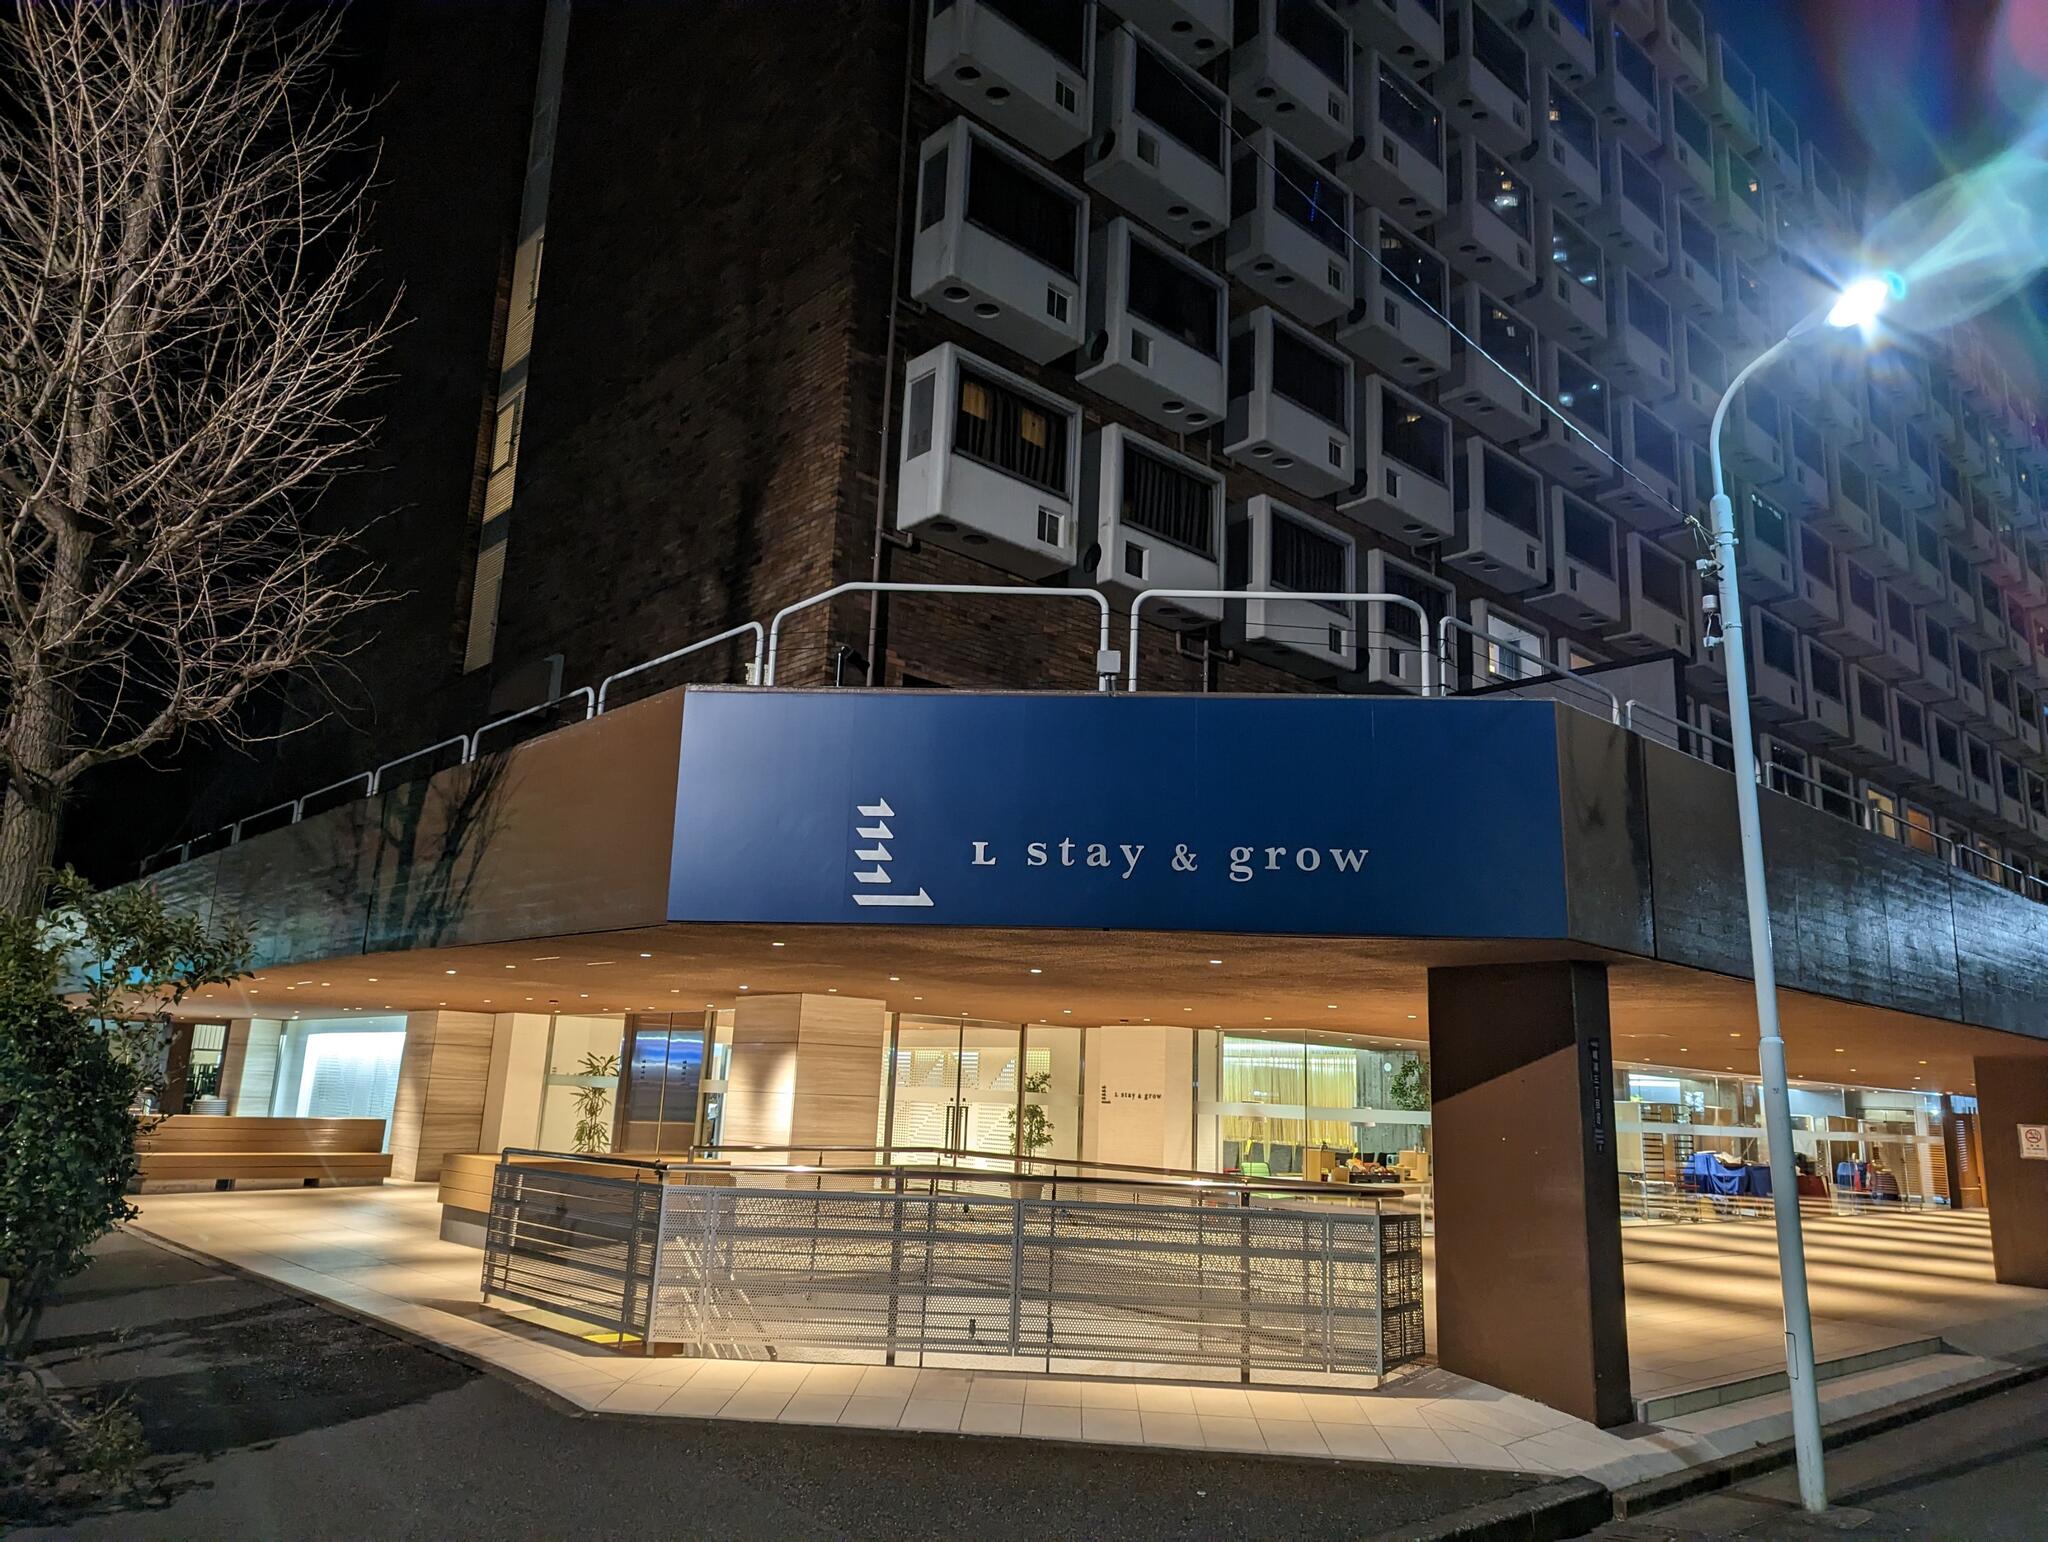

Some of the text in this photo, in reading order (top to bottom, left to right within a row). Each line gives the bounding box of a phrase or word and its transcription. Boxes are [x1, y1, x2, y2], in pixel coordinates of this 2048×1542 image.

[971, 836, 1369, 883] L stay & grow
[1121, 1092, 1135, 1100] stay
